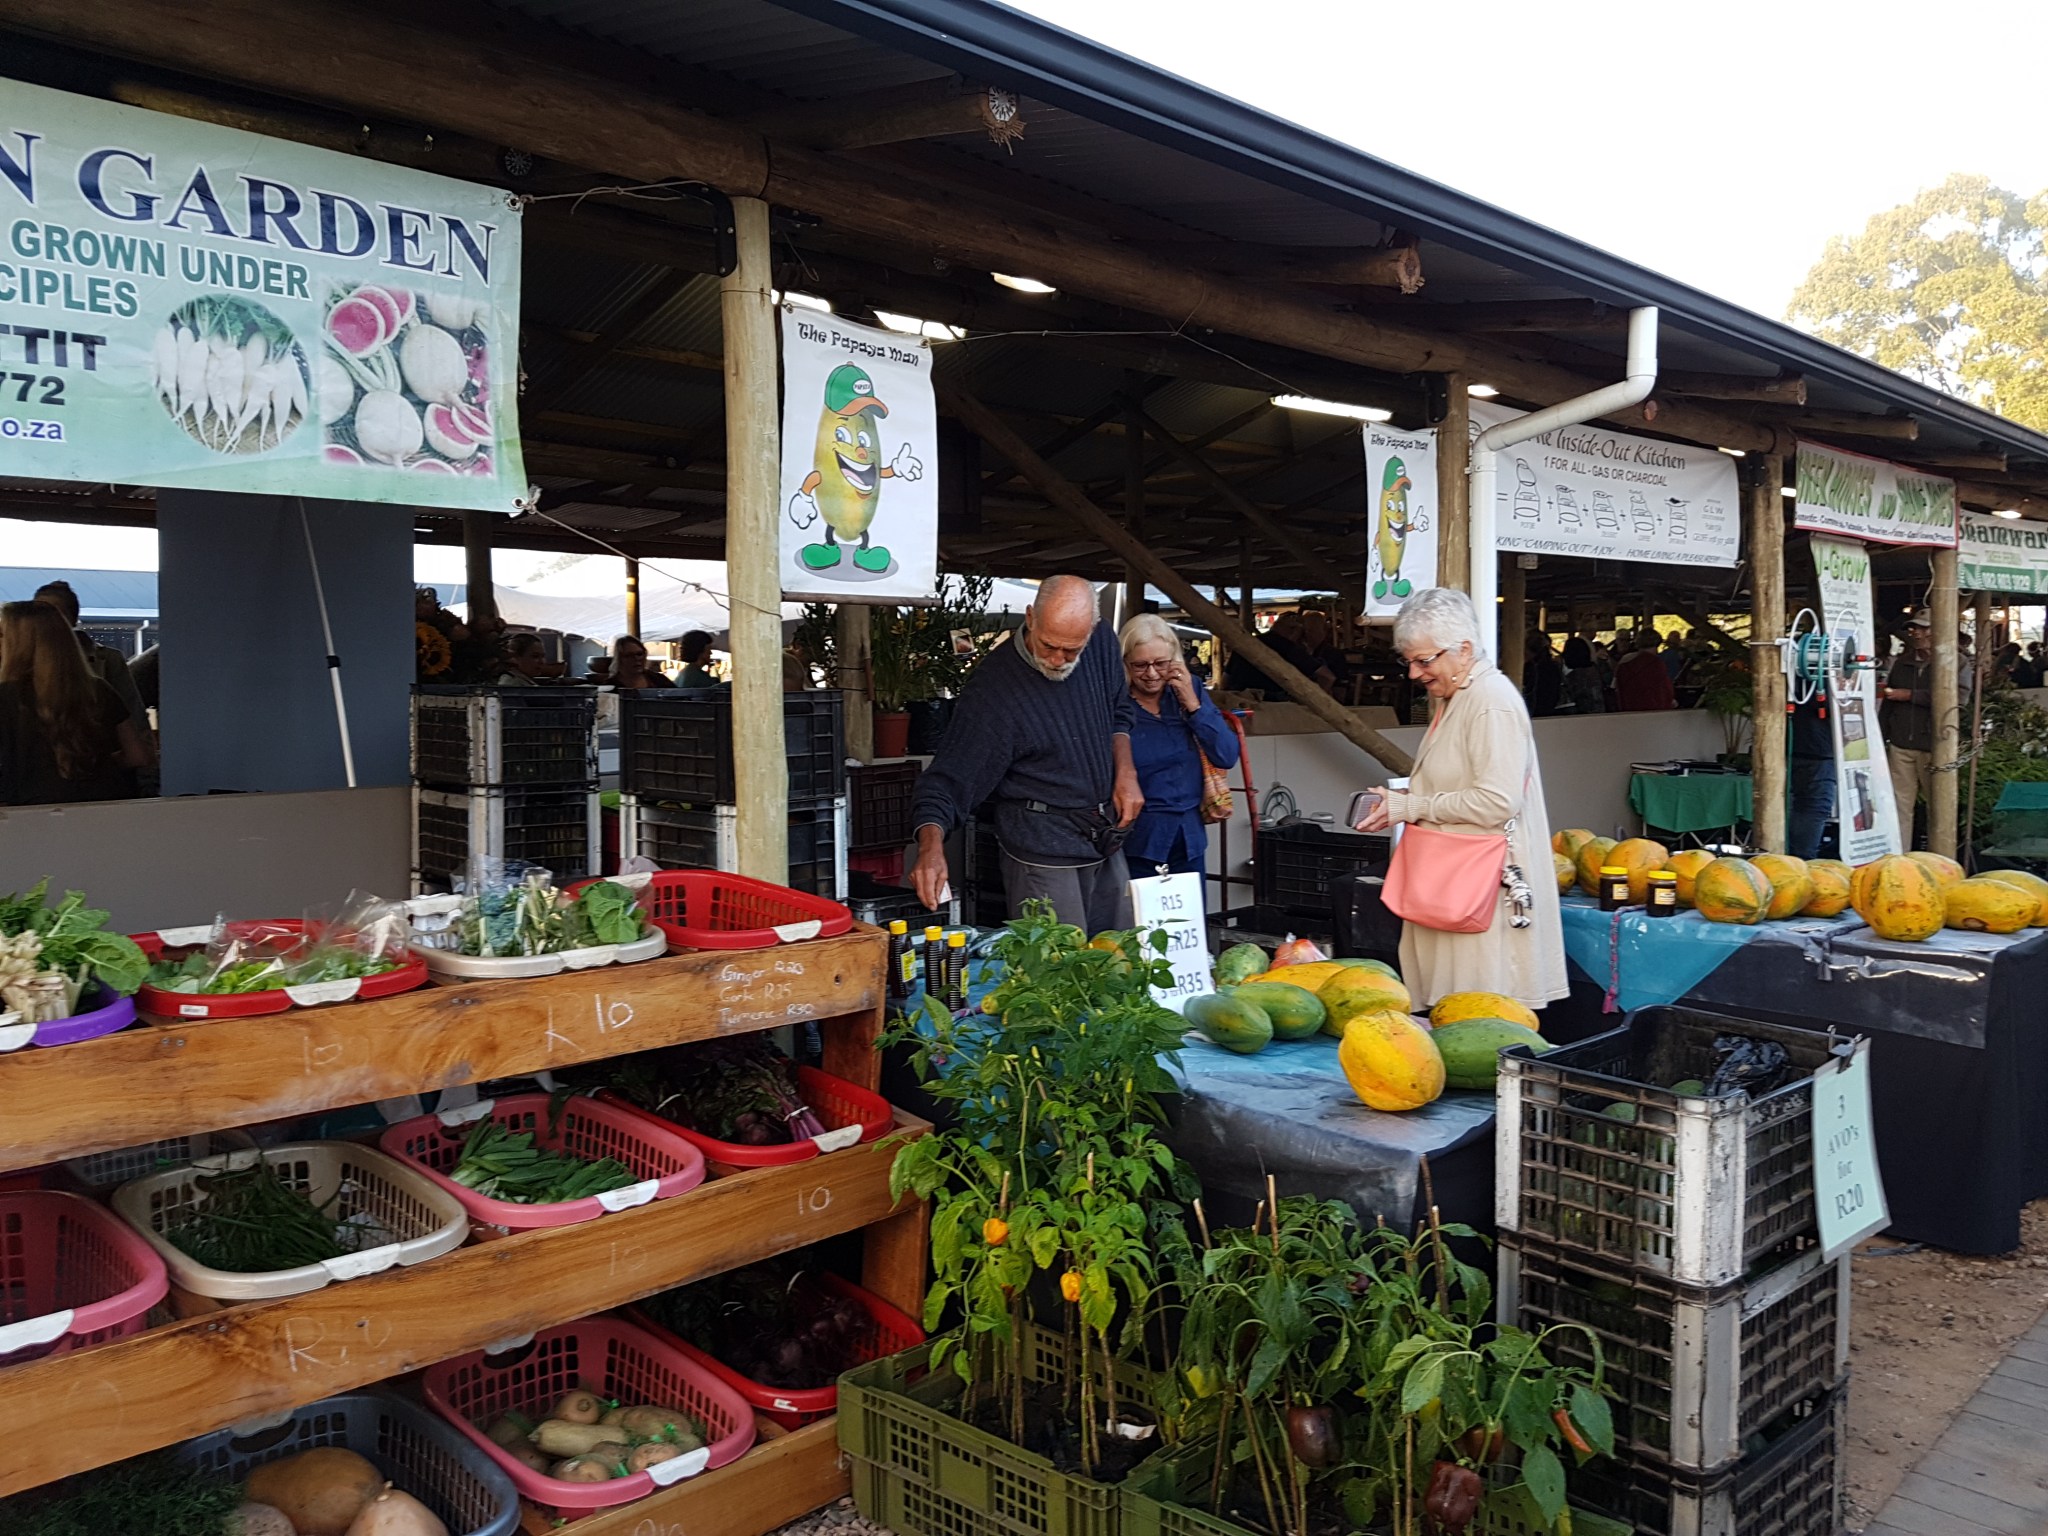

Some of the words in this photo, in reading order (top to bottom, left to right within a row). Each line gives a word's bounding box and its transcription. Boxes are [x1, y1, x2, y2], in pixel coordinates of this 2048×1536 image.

[77, 148, 497, 284] GARDEN
[12, 220, 166, 276] GROWN
[180, 245, 311, 299] UNDER
[798, 322, 827, 344] The
[831, 330, 885, 357] Papaya
[888, 347, 919, 367] Man
[1371, 434, 1386, 446] The
[1556, 428, 1629, 461] Inside-Out
[1634, 444, 1686, 470] Kitchen
[1550, 457, 1568, 471] FOR
[1612, 468, 1624, 480] OR
[1626, 469, 1668, 487] CHARCOAL
[1626, 549, 1651, 559] HOME
[1161, 894, 1183, 911] R15
[1175, 928, 1199, 950] R25
[1178, 972, 1204, 995] R35
[1837, 1094, 1845, 1119] 3
[1837, 1159, 1853, 1179] for
[1835, 1184, 1864, 1220] R20
